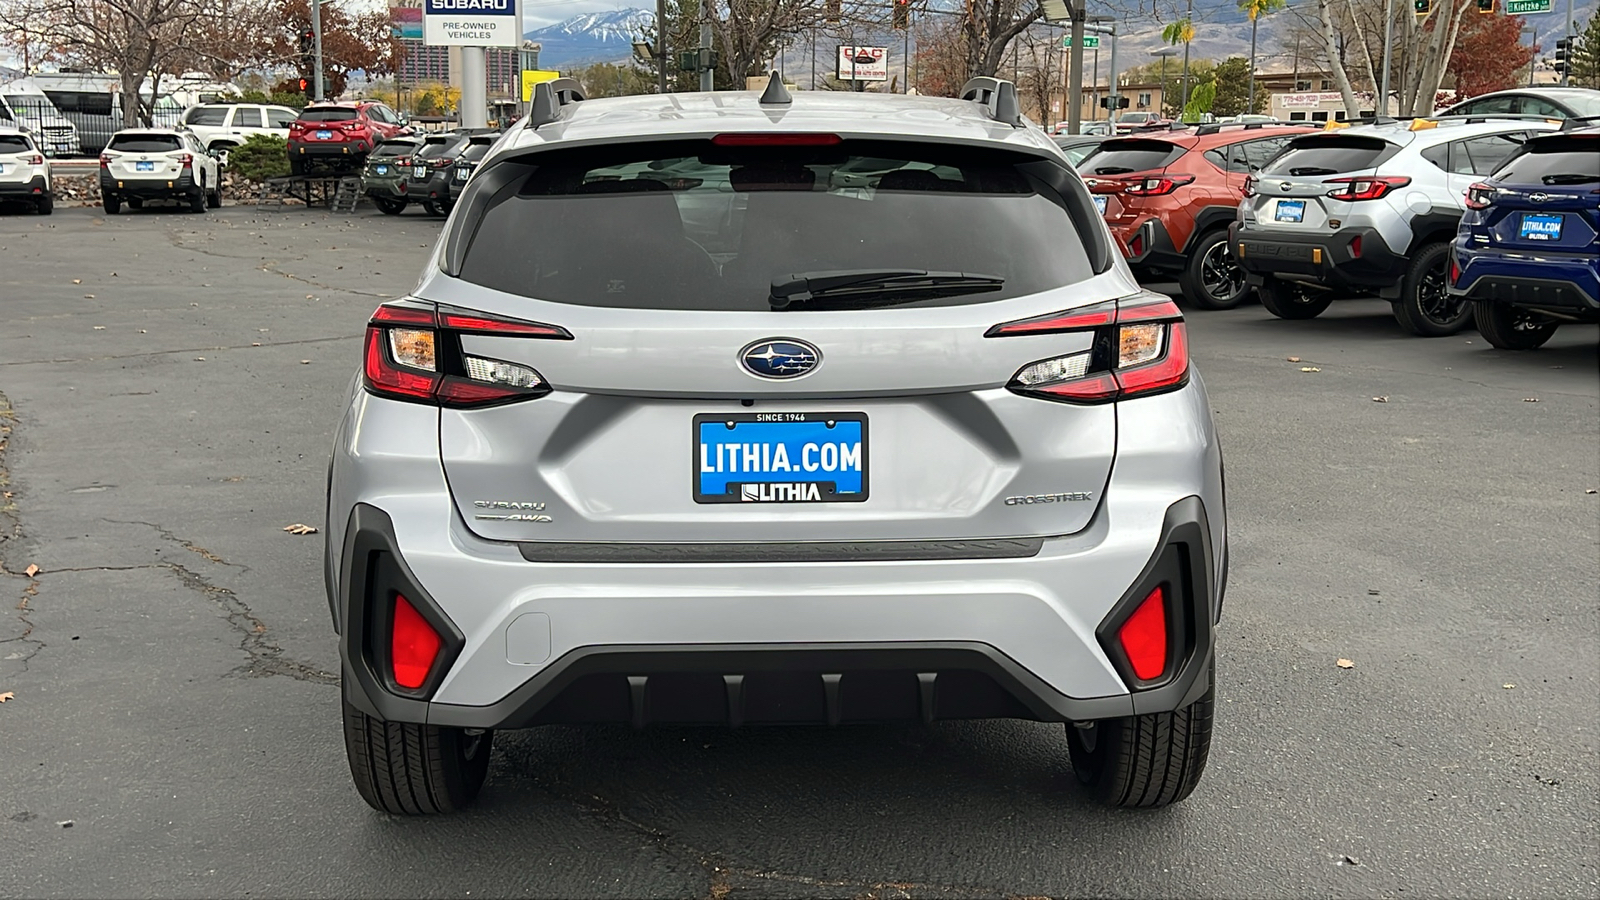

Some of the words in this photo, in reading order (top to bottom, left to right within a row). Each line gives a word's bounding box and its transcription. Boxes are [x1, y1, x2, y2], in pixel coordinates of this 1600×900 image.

[432, 0, 507, 9] SUBARU
[1513, 2, 1539, 11] Kietzke
[442, 22, 496, 30] PRE-OWNED
[448, 31, 491, 39] VEHICLES
[1522, 221, 1560, 232] LITHIA.COM
[756, 413, 783, 422] SINCE
[785, 413, 805, 422] 1946
[701, 442, 862, 473] LITHIA.COM
[760, 483, 821, 501] LITHIA
[1004, 491, 1093, 507] CROSSTREK
[474, 500, 546, 512] SUBARU
